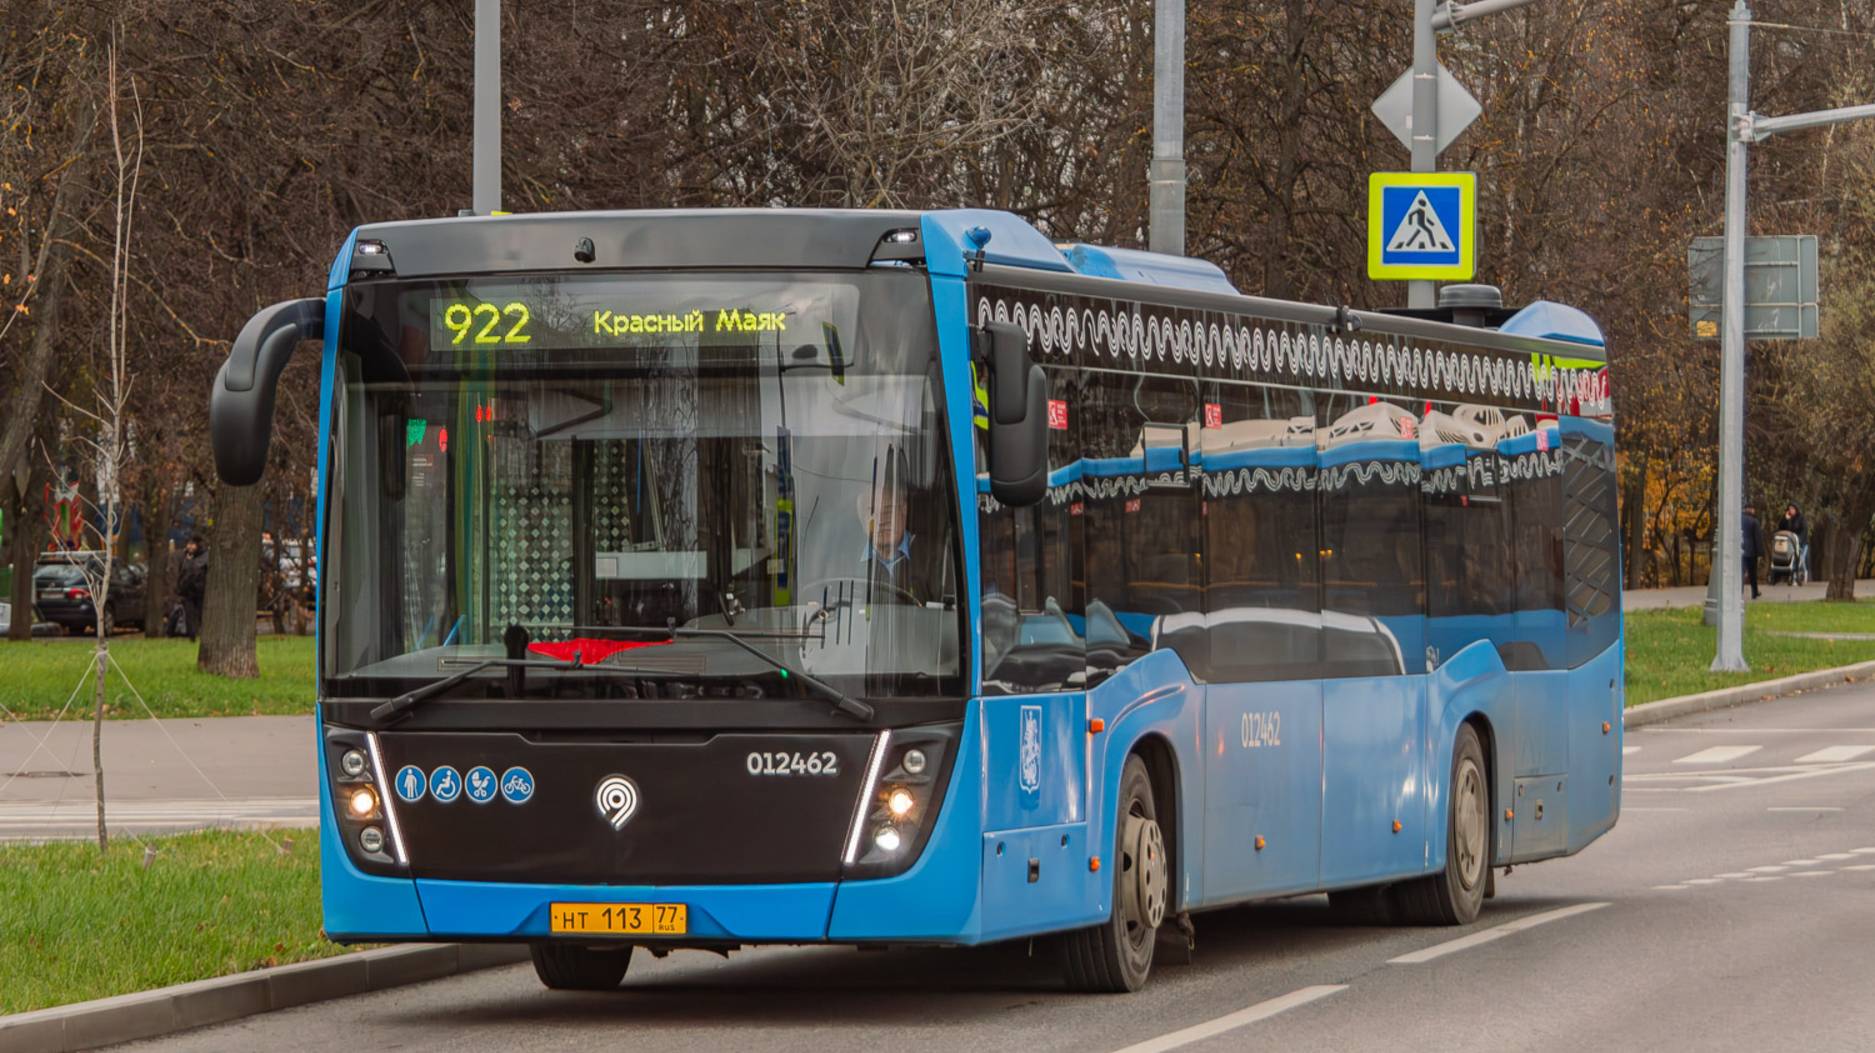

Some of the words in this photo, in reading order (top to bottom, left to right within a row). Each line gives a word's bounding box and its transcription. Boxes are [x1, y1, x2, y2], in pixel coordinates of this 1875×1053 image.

[444, 302, 531, 345] 922
[594, 309, 704, 336] Красный
[715, 308, 787, 332] Маяк
[1241, 711, 1281, 748] 012462
[746, 752, 838, 775] 012462
[563, 911, 589, 929] НТ
[602, 907, 642, 930] 113
[656, 906, 678, 923] 77
